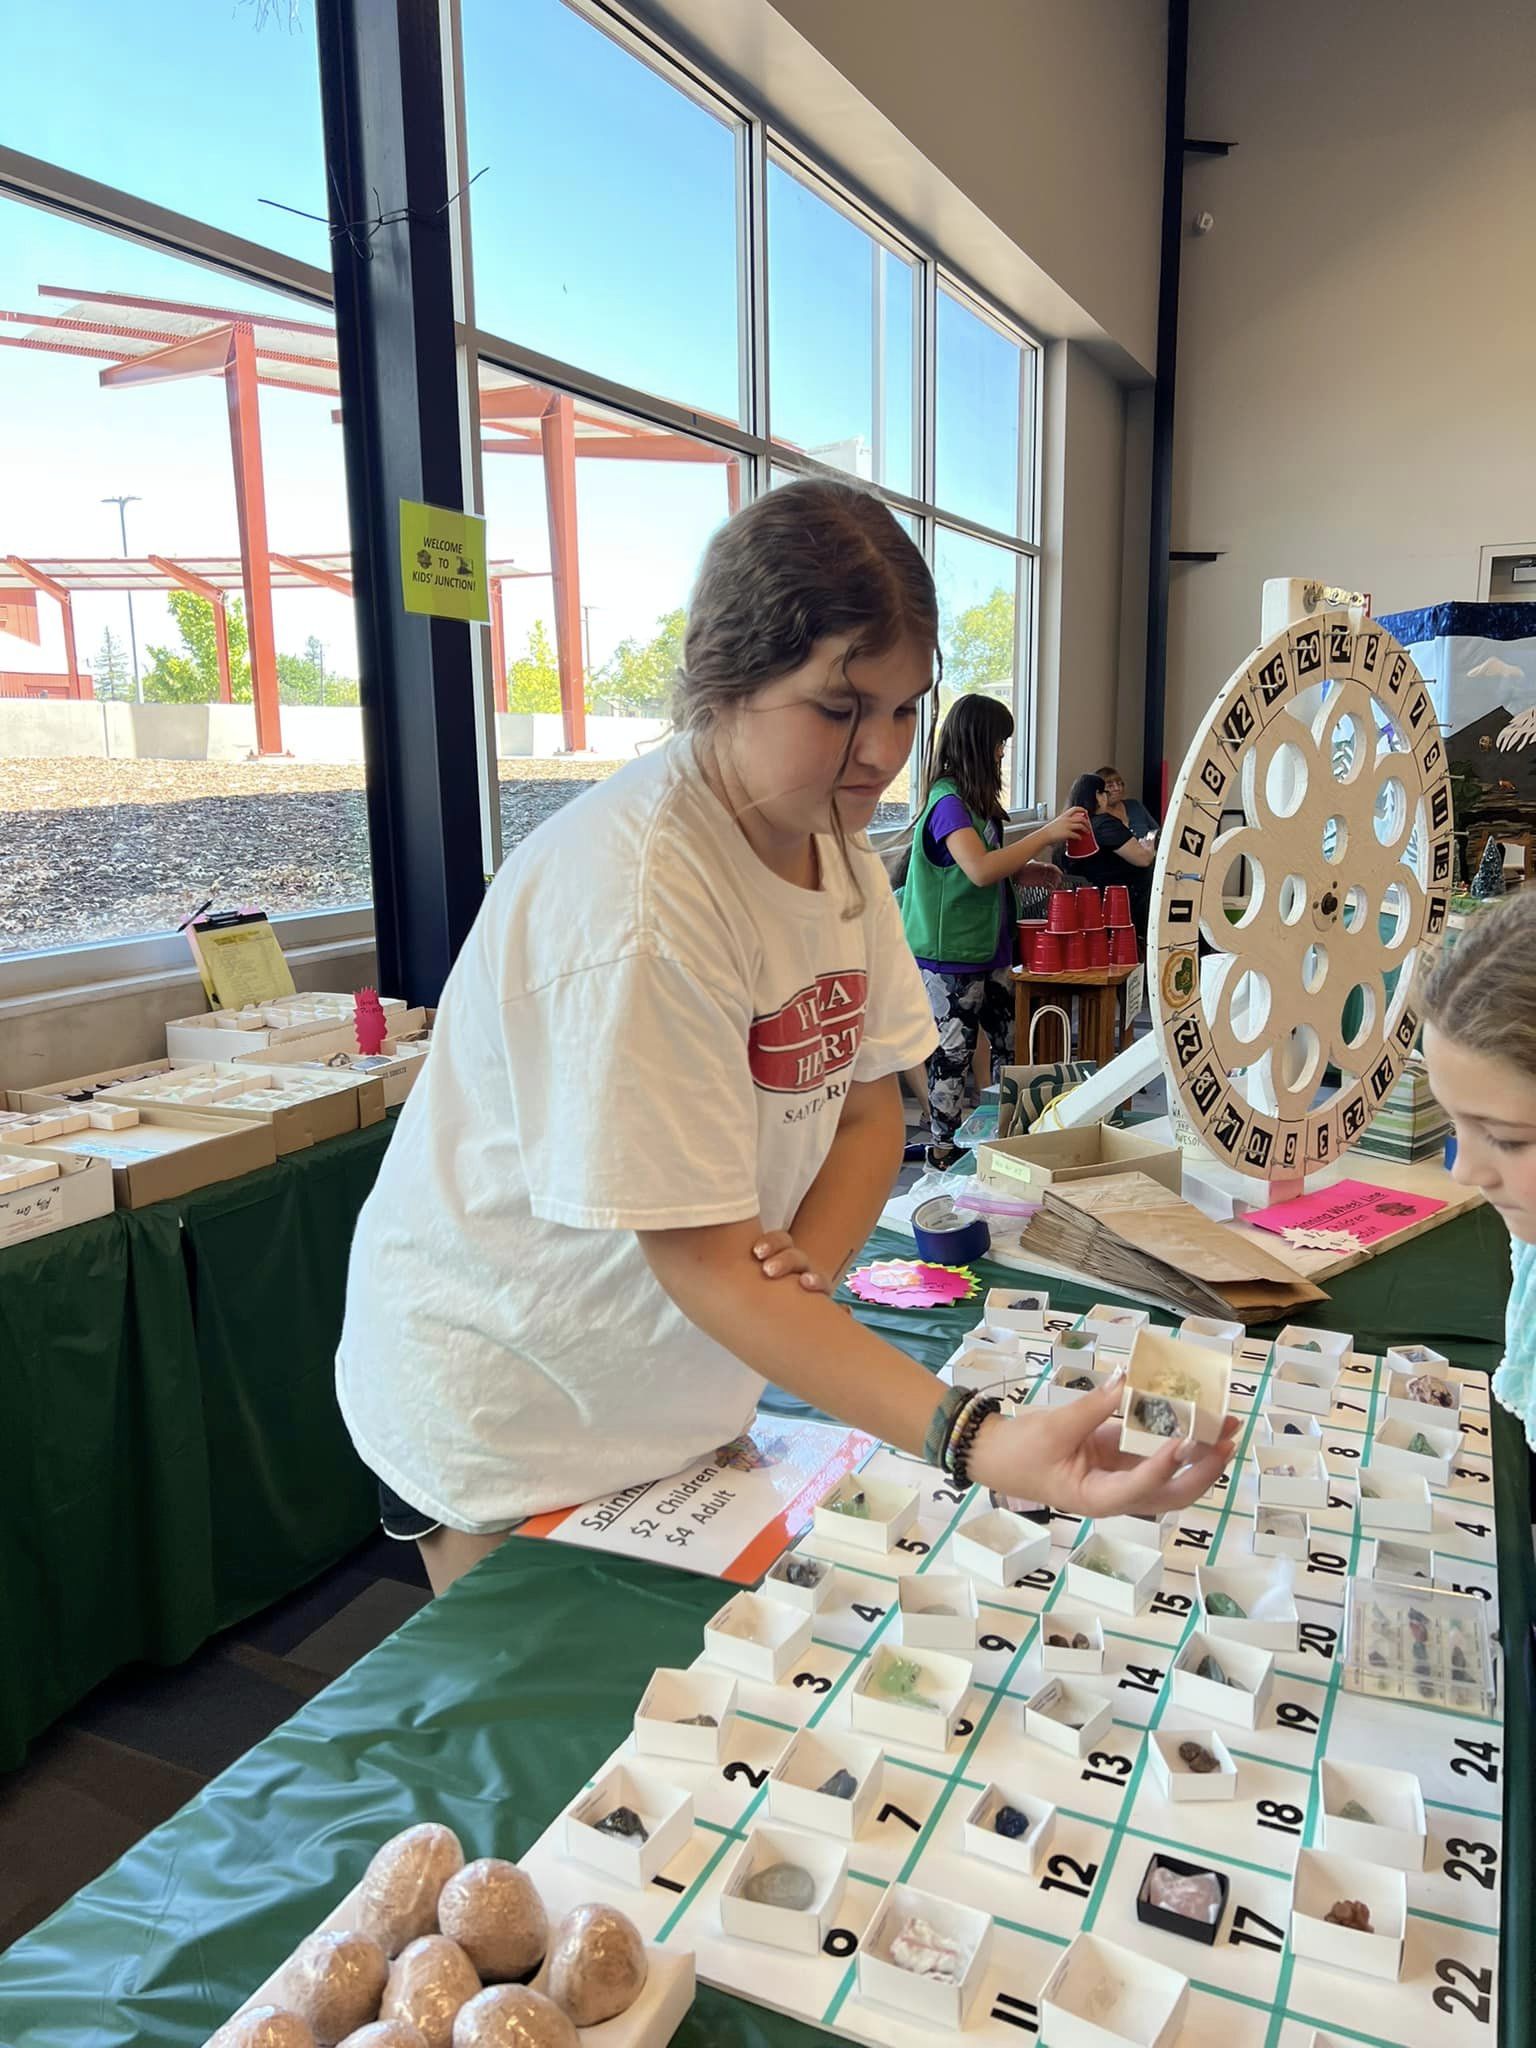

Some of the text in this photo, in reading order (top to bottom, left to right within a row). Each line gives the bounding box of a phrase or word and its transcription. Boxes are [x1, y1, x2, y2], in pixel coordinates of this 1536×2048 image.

[423, 537, 463, 553] WELCOME
[438, 557, 450, 569] TO
[434, 577, 476, 592] JUNCTION!
[1299, 635, 1321, 669] 20
[1331, 629, 1351, 658] 24
[1366, 638, 1377, 666] 2
[1261, 659, 1286, 701] 16
[1391, 661, 1404, 685] 5
[1227, 701, 1253, 743] 12
[1411, 702, 1425, 722] 7
[1426, 749, 1438, 767] 9
[1205, 766, 1220, 788] 8
[1434, 790, 1447, 826] 11
[1184, 831, 1202, 848] 4
[1435, 849, 1448, 877] 13
[1430, 902, 1445, 932] 15
[1178, 1017, 1199, 1061] 22
[1400, 1011, 1416, 1042] 19
[1198, 1071, 1217, 1107] 18
[1374, 1062, 1393, 1096] 21
[1217, 1108, 1240, 1148] 14
[1344, 1101, 1364, 1136] 23
[1250, 1136, 1270, 1161] 10
[1318, 1132, 1328, 1153] 3
[1240, 1350, 1267, 1362] 11
[1344, 1364, 1372, 1375] 6
[1230, 1382, 1257, 1397] 12
[1336, 1402, 1367, 1414] 7
[1460, 1423, 1488, 1437] 2
[1327, 1446, 1360, 1459] 8
[1455, 1468, 1490, 1483] 3
[630, 1465, 719, 1539] $2 Children
[665, 1488, 737, 1547] $4 Adult
[1454, 1521, 1491, 1538] 4
[895, 1538, 931, 1556] 5
[1174, 1527, 1214, 1550] 14
[1307, 1551, 1347, 1577] 10
[1014, 1568, 1056, 1593] 10
[851, 1602, 886, 1623] 4
[1150, 1592, 1192, 1618] 15
[978, 1634, 1018, 1653] 9
[1299, 1622, 1338, 1660] 20
[793, 1672, 832, 1694] 3
[1118, 1664, 1165, 1695] 14
[1276, 1702, 1320, 1735] 19
[1081, 1751, 1133, 1787] 13
[1450, 1737, 1501, 1783] 24
[723, 1762, 770, 1789] 2
[876, 1803, 922, 1833] 7
[1256, 1800, 1304, 1835] 18
[1039, 1854, 1098, 1899] 12
[1443, 1838, 1498, 1890] 23
[1228, 1905, 1285, 1953] 17
[1432, 1957, 1493, 2024] 22
[990, 1992, 1039, 2034] 11
